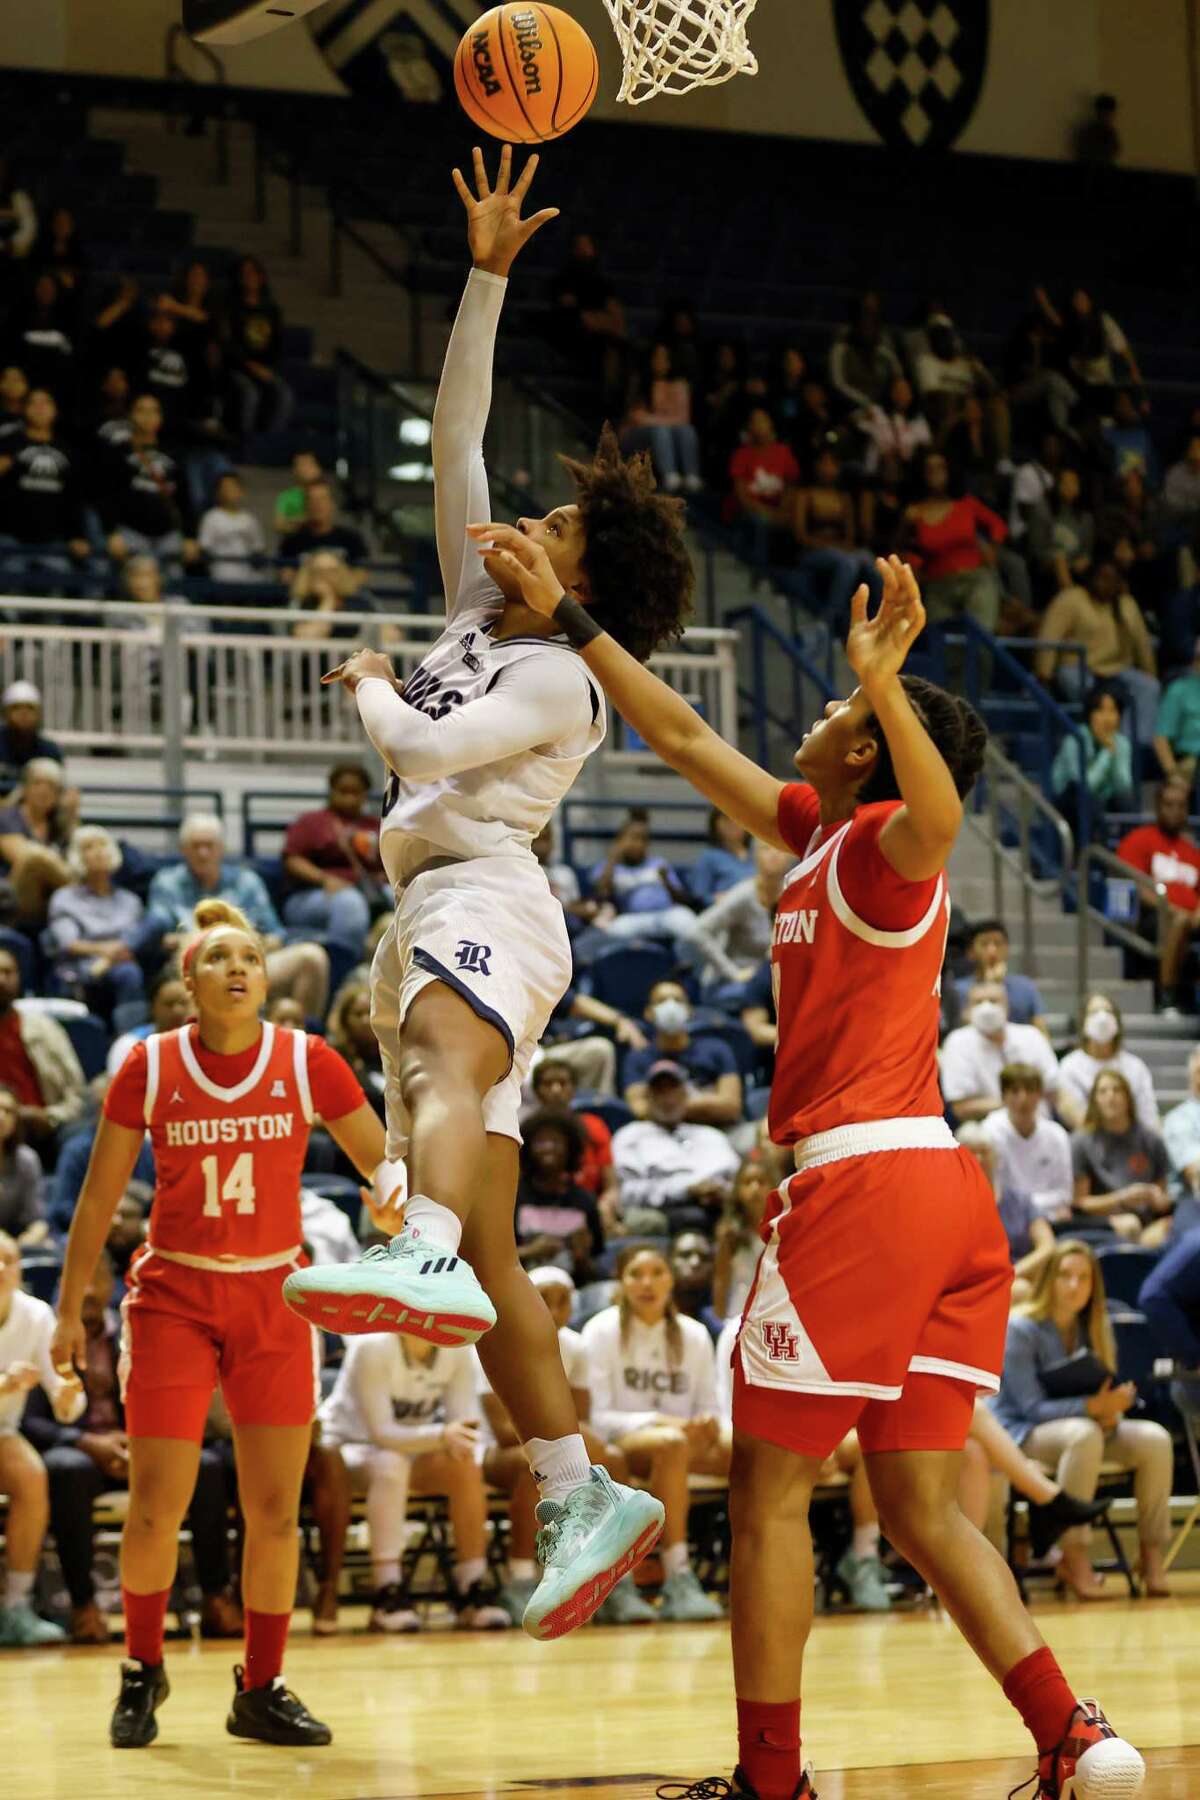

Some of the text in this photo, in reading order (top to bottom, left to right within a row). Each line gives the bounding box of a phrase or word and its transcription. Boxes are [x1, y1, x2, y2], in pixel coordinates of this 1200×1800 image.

[473, 30, 502, 97] NCAA
[511, 10, 543, 96] Wilson
[772, 909, 819, 945] TON
[165, 1112, 294, 1146] HOUSTON
[201, 1152, 256, 1218] 14
[623, 1366, 688, 1395] RICE
